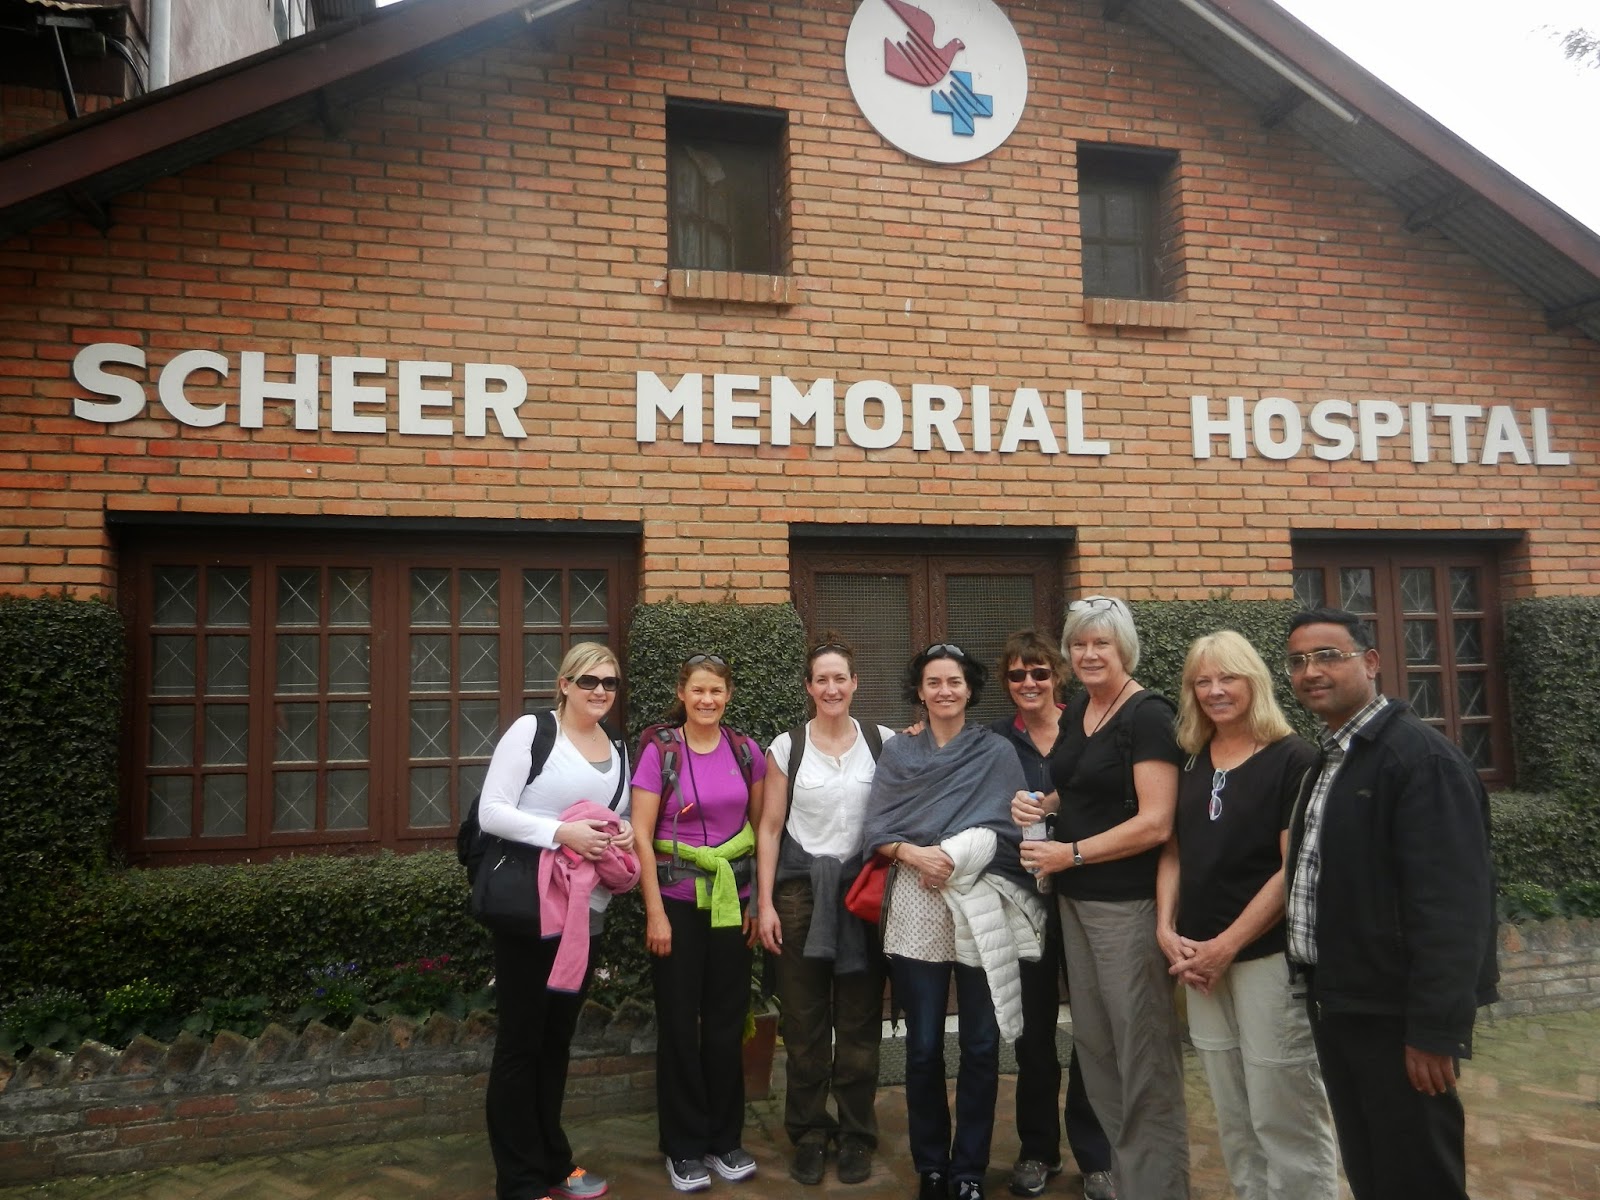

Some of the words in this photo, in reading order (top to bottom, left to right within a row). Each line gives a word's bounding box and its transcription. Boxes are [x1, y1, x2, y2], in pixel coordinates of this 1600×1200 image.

[73, 342, 529, 439] SCHEER
[635, 370, 1111, 455] MEMORIAL
[1190, 394, 1570, 466] HOSPITAL
